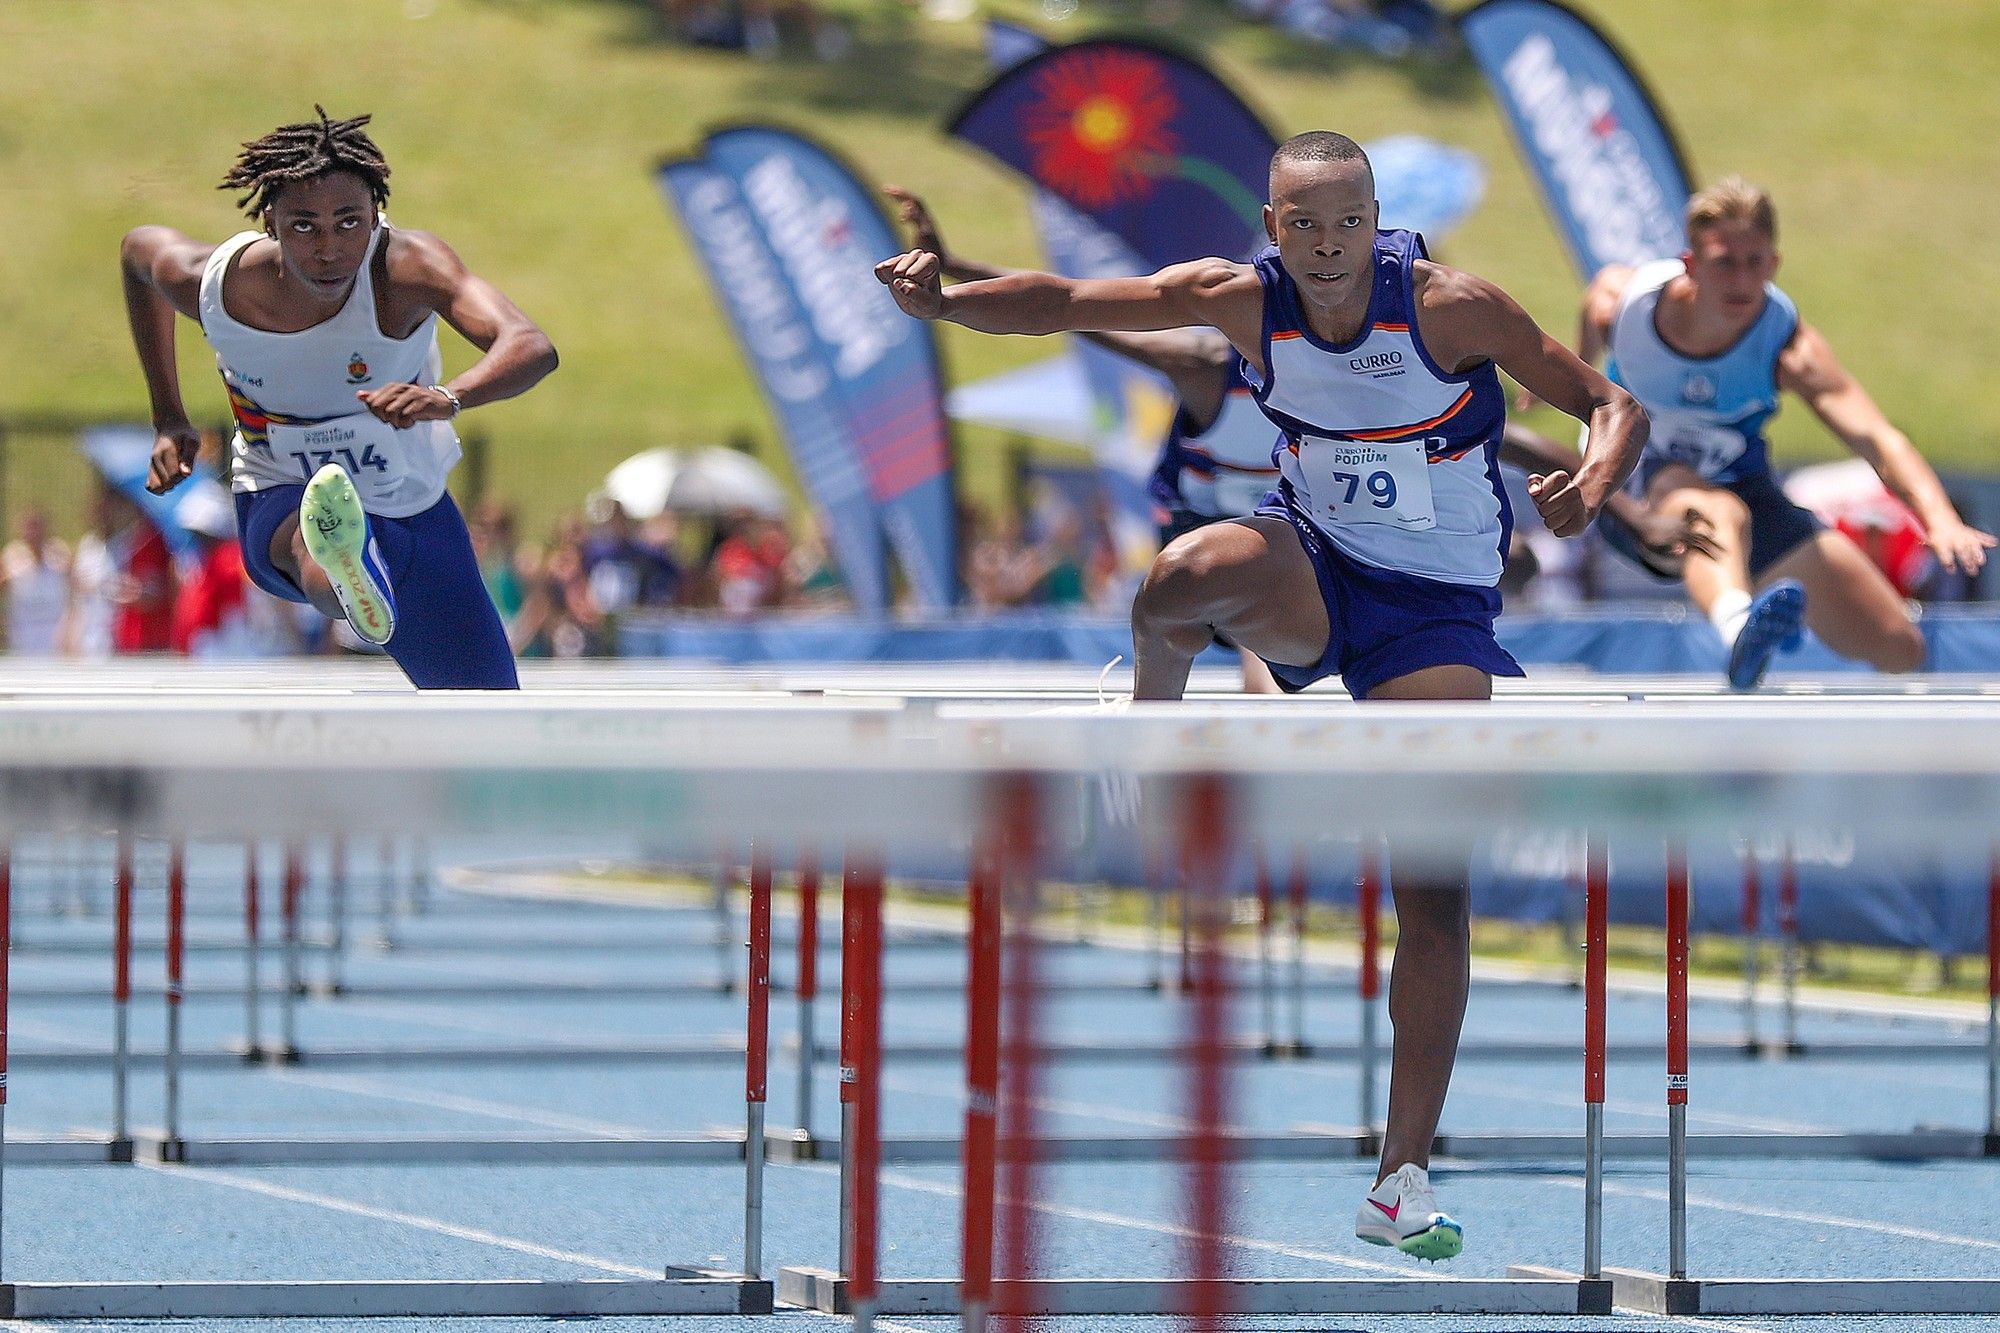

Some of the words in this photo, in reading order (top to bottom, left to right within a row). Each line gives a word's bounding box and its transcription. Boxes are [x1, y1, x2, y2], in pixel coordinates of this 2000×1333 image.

[1350, 351, 1403, 370] CURRO
[1335, 447, 1361, 455] CURRO
[1335, 453, 1388, 465] PODIUM
[1332, 470, 1397, 509] 79
